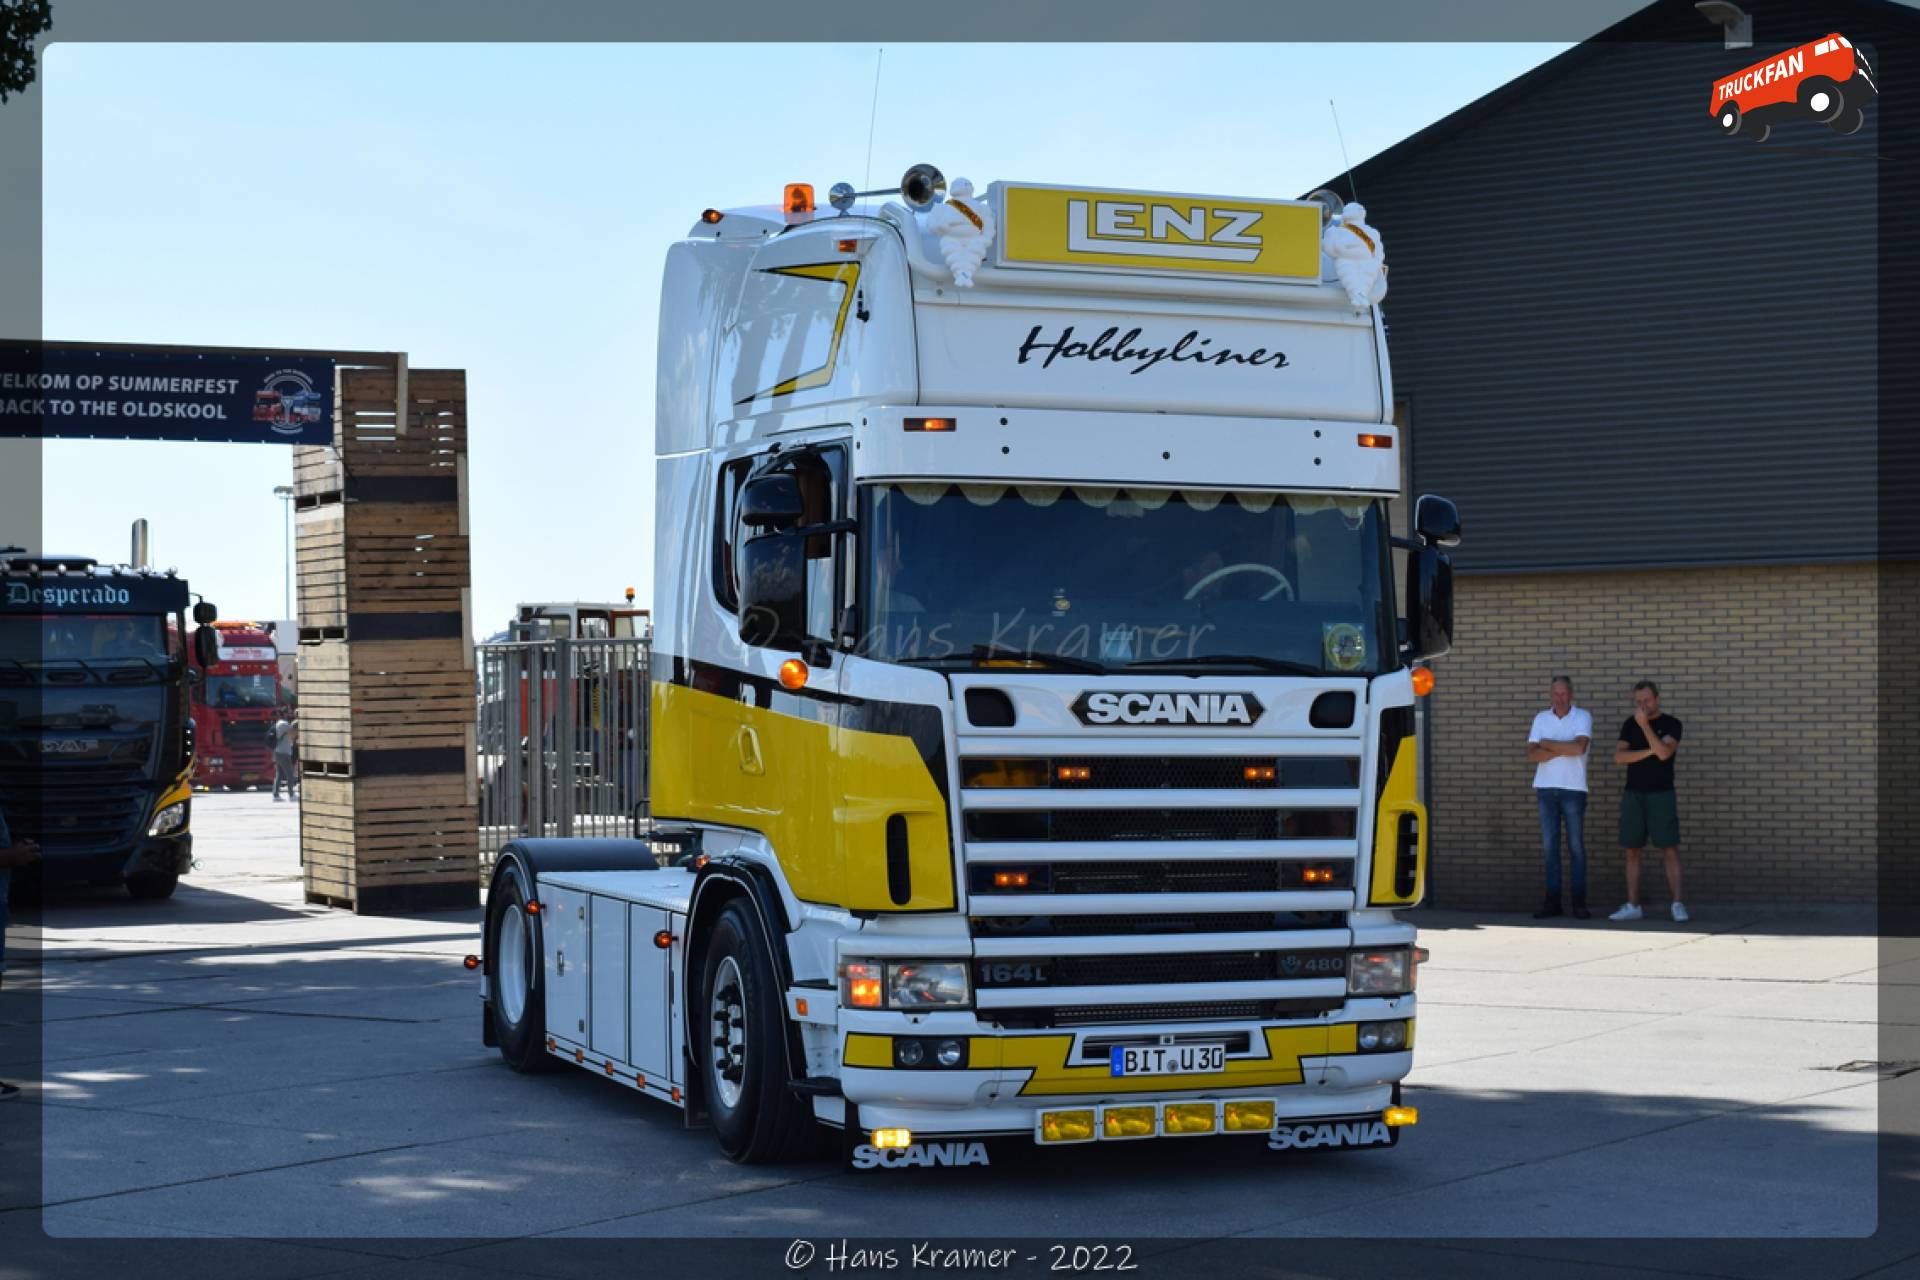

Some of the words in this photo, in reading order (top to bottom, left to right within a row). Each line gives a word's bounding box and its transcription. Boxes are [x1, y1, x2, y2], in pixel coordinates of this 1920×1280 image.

[1067, 199, 1263, 264] LENZ
[1017, 325, 1290, 374] Hobbyliner
[0, 373, 70, 390] ELKOM
[75, 375, 103, 390] OP
[108, 375, 239, 394] SUMMERFEST
[50, 399, 75, 415] TO
[80, 400, 117, 416] THE
[122, 401, 228, 419] OLDSKOOL
[5, 582, 130, 606] Desperado
[1086, 693, 1252, 724] SCANIA
[1305, 957, 1344, 972] 480
[1125, 1050, 1166, 1073] BIT
[1268, 1122, 1391, 1150] SCANIA
[852, 1142, 990, 1169] SCANIA
